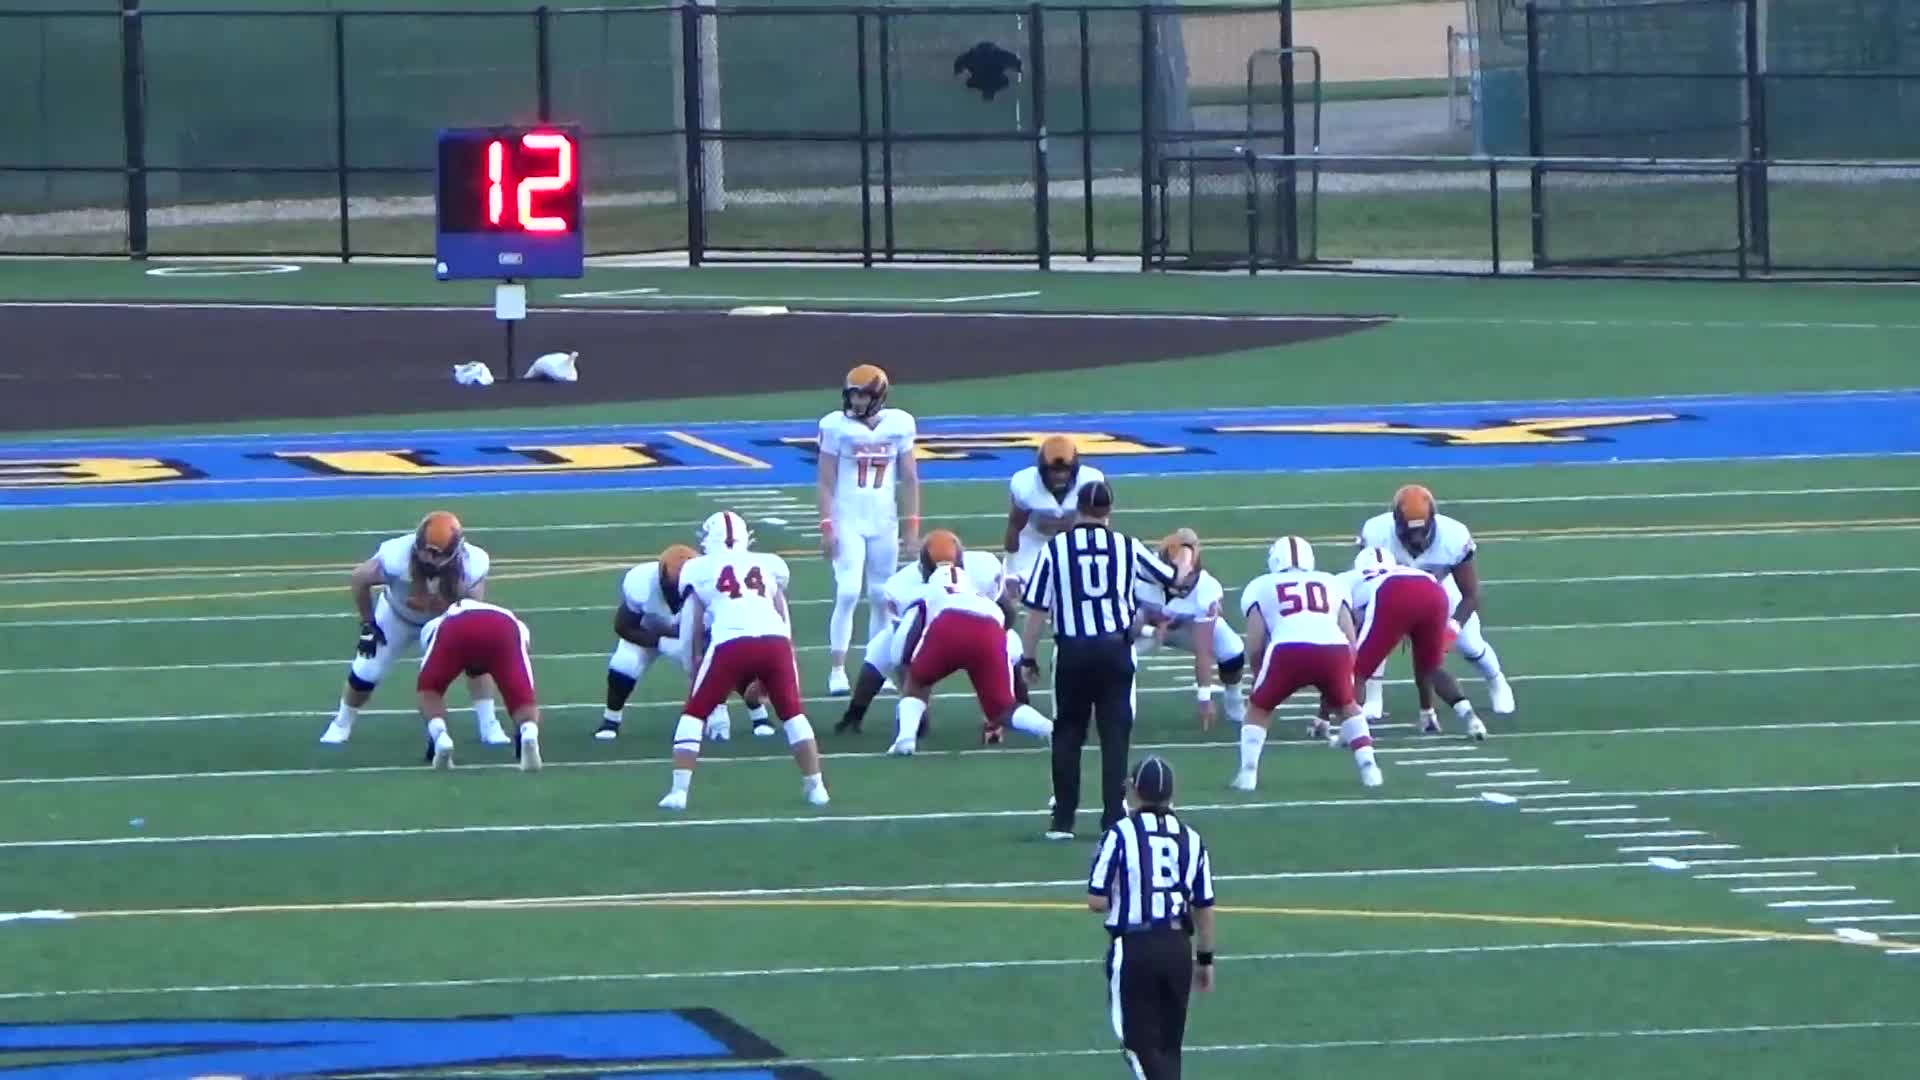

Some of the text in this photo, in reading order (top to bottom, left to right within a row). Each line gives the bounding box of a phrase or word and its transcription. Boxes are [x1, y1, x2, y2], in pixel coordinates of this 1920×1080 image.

[488, 134, 571, 231] 12
[857, 456, 890, 489] 17
[716, 565, 766, 599] 44
[1077, 554, 1110, 597] U
[1275, 581, 1330, 617] 50
[1147, 834, 1181, 888] B
